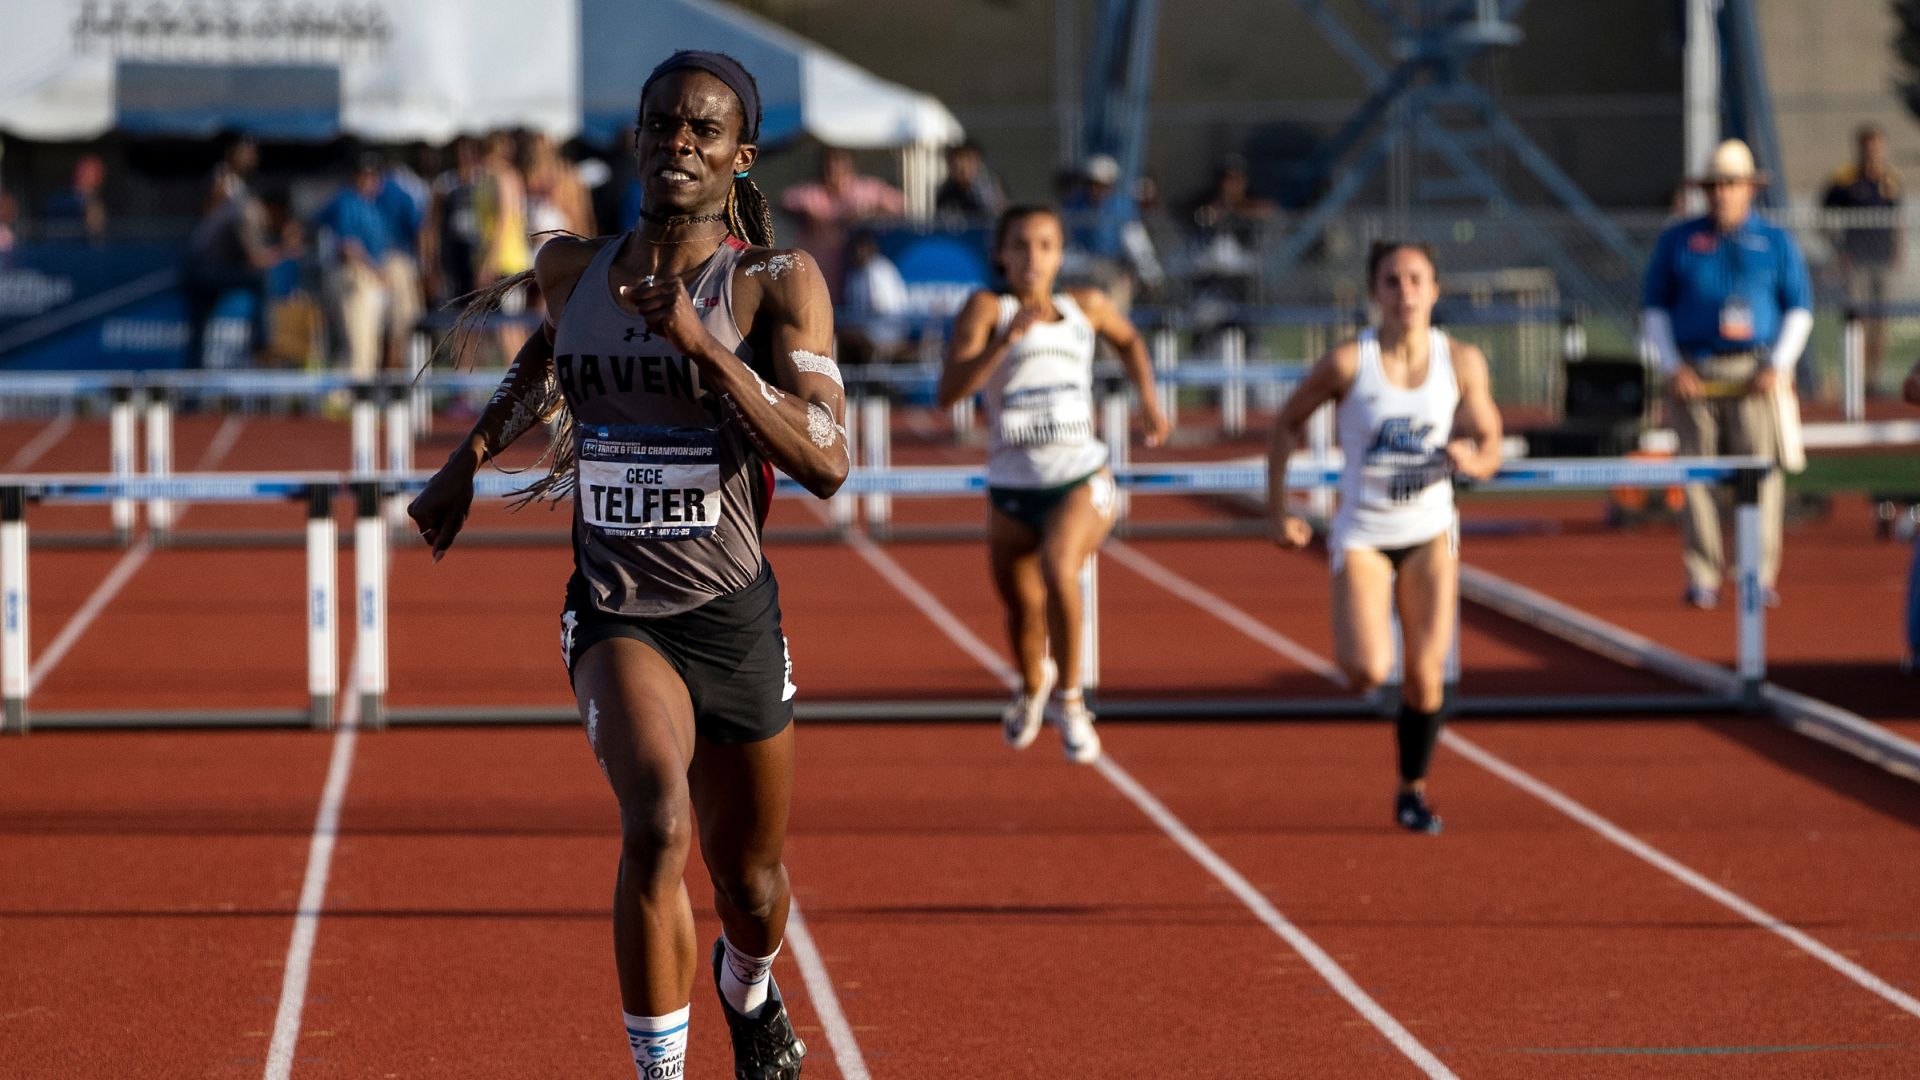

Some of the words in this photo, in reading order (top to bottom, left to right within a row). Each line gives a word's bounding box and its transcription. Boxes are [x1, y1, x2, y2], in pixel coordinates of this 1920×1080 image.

[598, 445, 619, 454] TRACK
[620, 446, 626, 454] &
[627, 446, 646, 455] FIELD
[648, 446, 713, 456] CHAMPIONSHIPS
[626, 468, 663, 484] CECE
[590, 485, 706, 523] TELFER
[637, 528, 646, 537] TX
[657, 528, 671, 536] MAY
